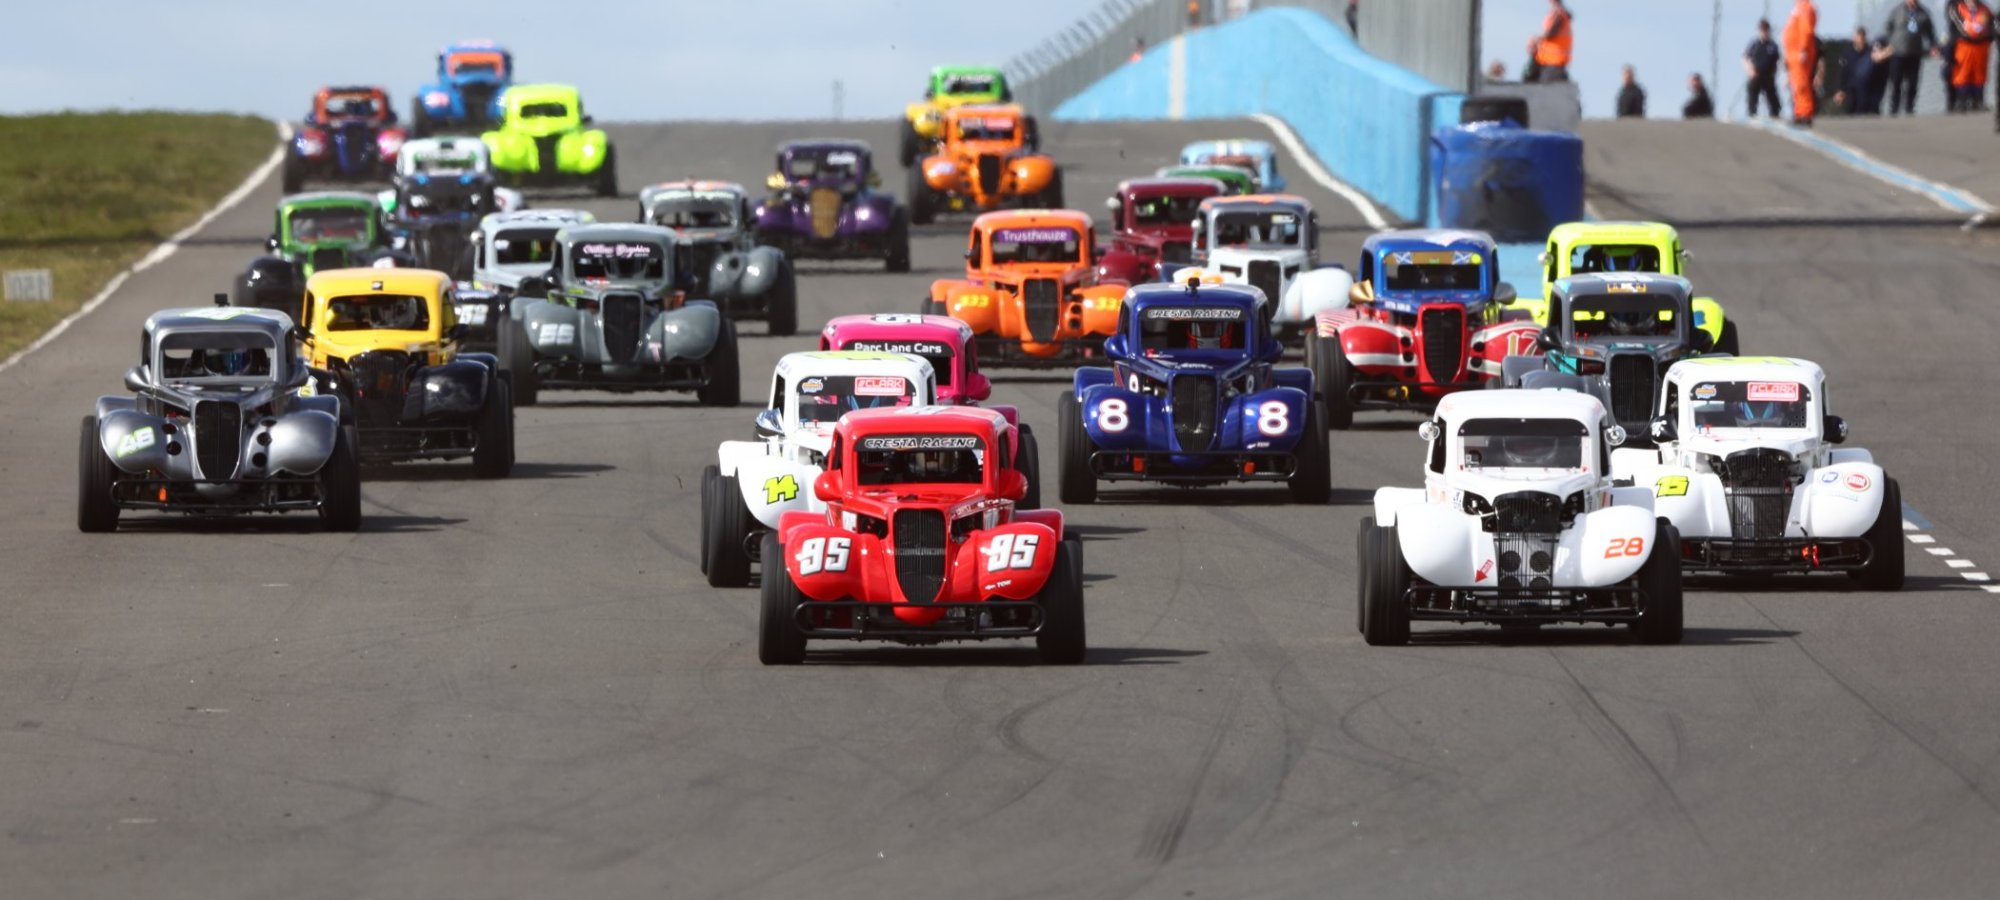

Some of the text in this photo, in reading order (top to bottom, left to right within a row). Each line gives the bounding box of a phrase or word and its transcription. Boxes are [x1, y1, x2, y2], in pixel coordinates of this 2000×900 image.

[1148, 308, 1192, 318] CRESTA
[854, 342, 942, 353] Parc Lane Cars
[1098, 398, 1129, 433] 8
[1258, 400, 1289, 437] 8
[864, 437, 977, 449] CRESTA RACING
[762, 473, 799, 505] 14
[799, 536, 852, 576] 95
[987, 533, 1039, 573] 95
[1603, 537, 1644, 559] 28
